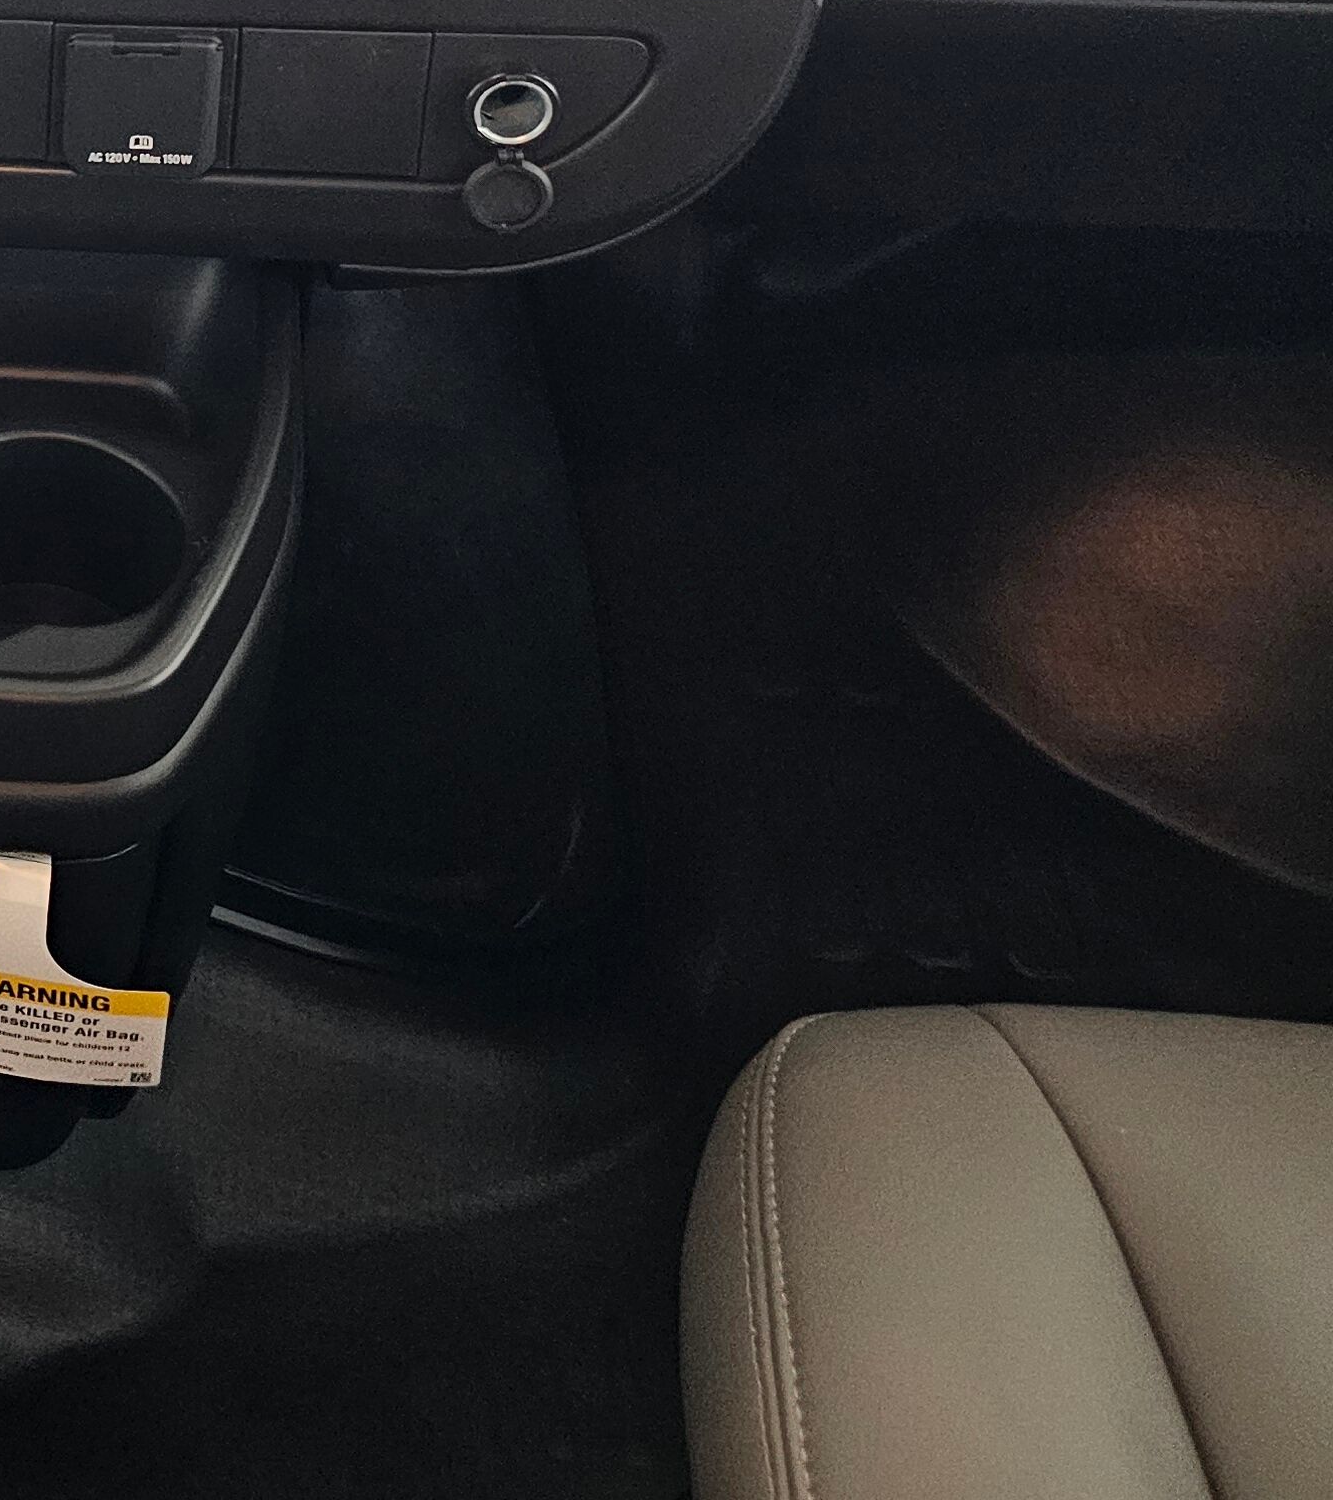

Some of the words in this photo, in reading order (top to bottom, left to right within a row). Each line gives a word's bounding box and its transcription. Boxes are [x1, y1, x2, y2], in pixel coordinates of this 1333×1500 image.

[87, 152, 103, 163] AC
[139, 153, 162, 165] Max
[15, 1005, 75, 1023] KILLED
[82, 1018, 100, 1026] or
[74, 1027, 100, 1037] Air
[106, 1030, 144, 1042] Bag.
